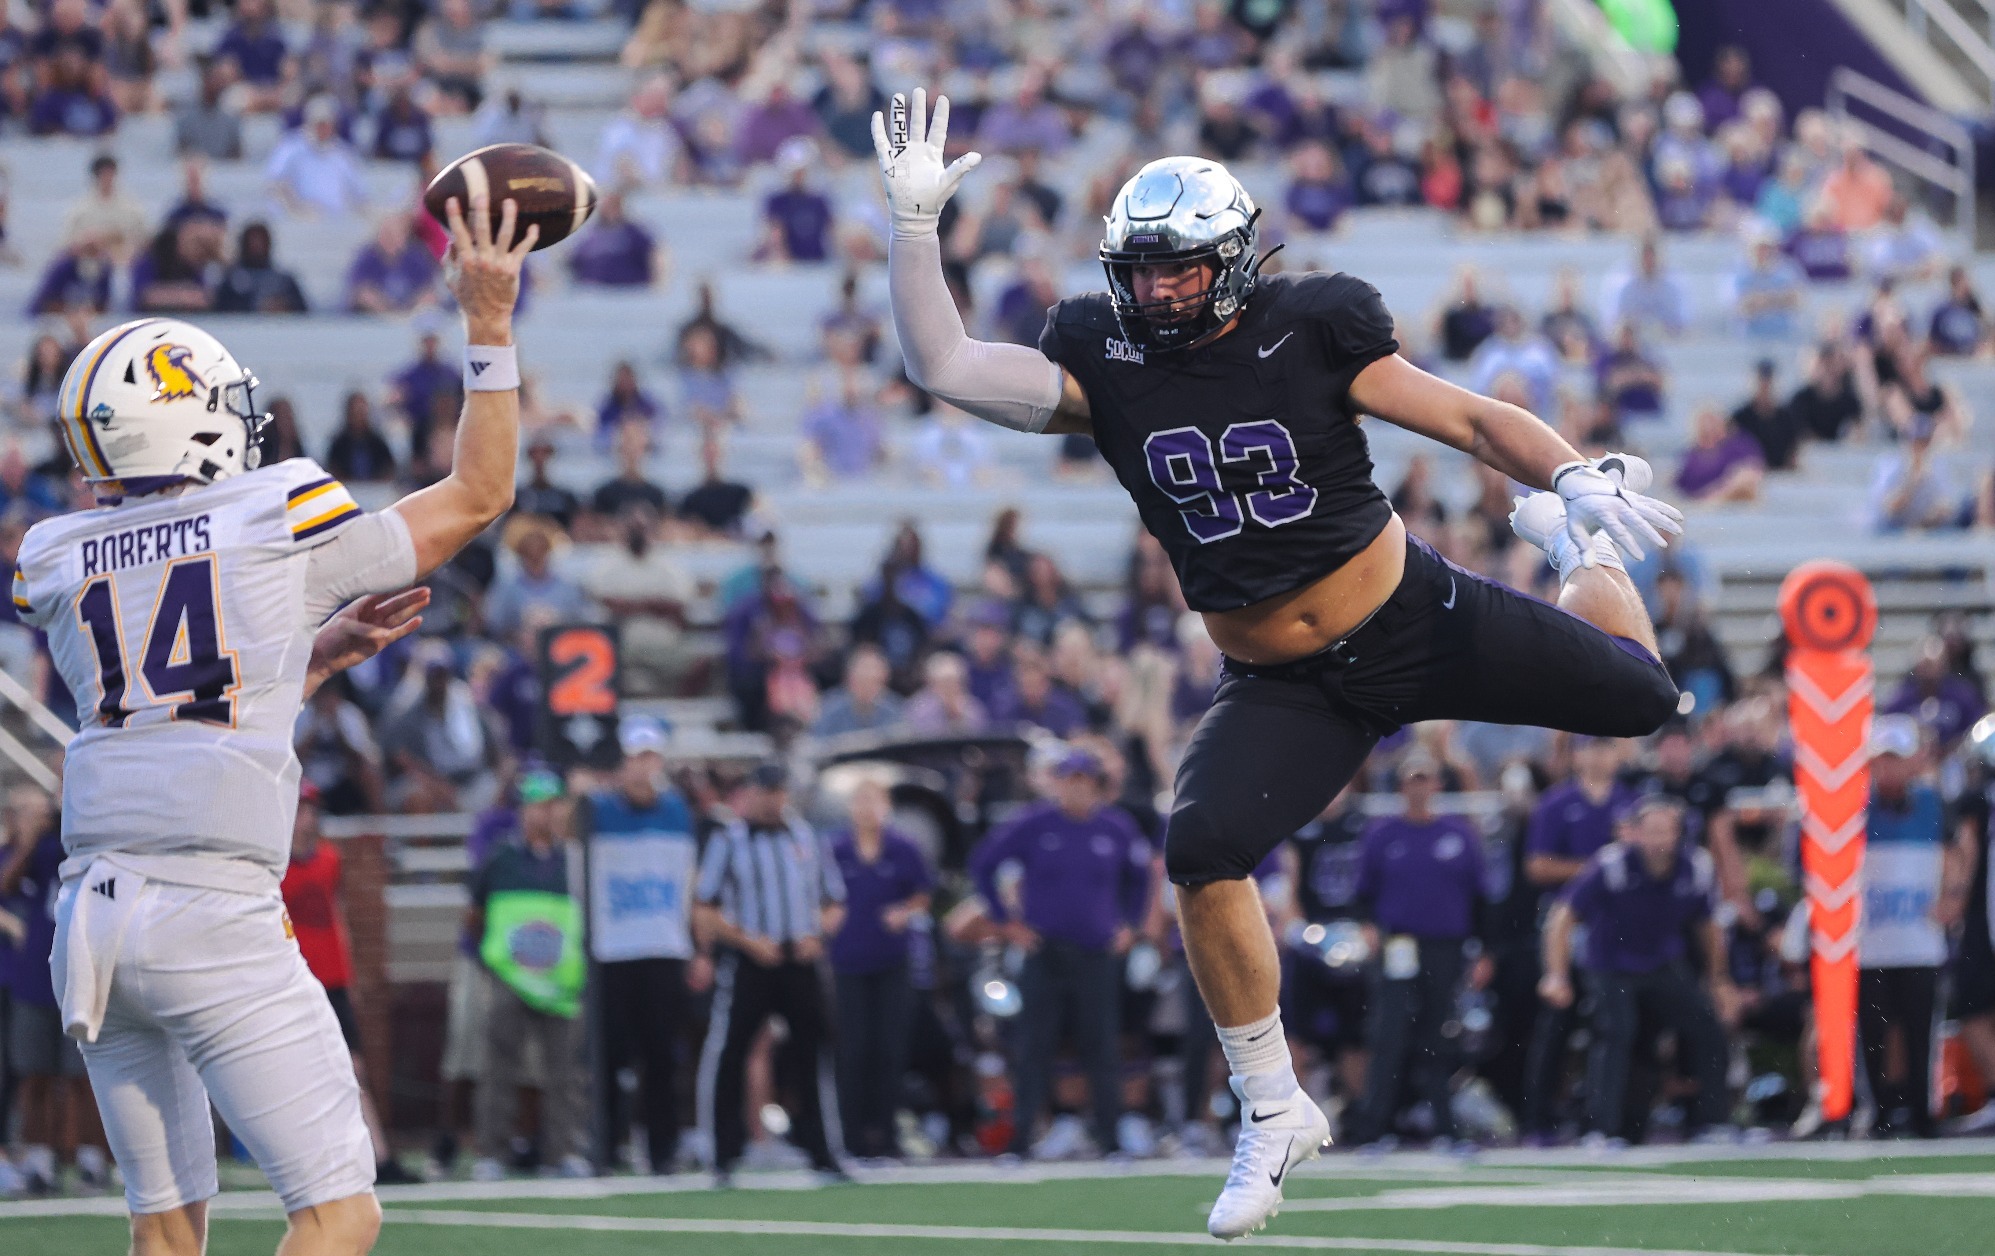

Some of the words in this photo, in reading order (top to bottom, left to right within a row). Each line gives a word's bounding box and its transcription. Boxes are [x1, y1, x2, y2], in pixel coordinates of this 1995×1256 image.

[893, 97, 907, 159] ALPHA
[1143, 419, 1318, 544] 93
[82, 513, 212, 577] ROBERTS
[74, 551, 243, 729] 14
[549, 628, 617, 716] 2
